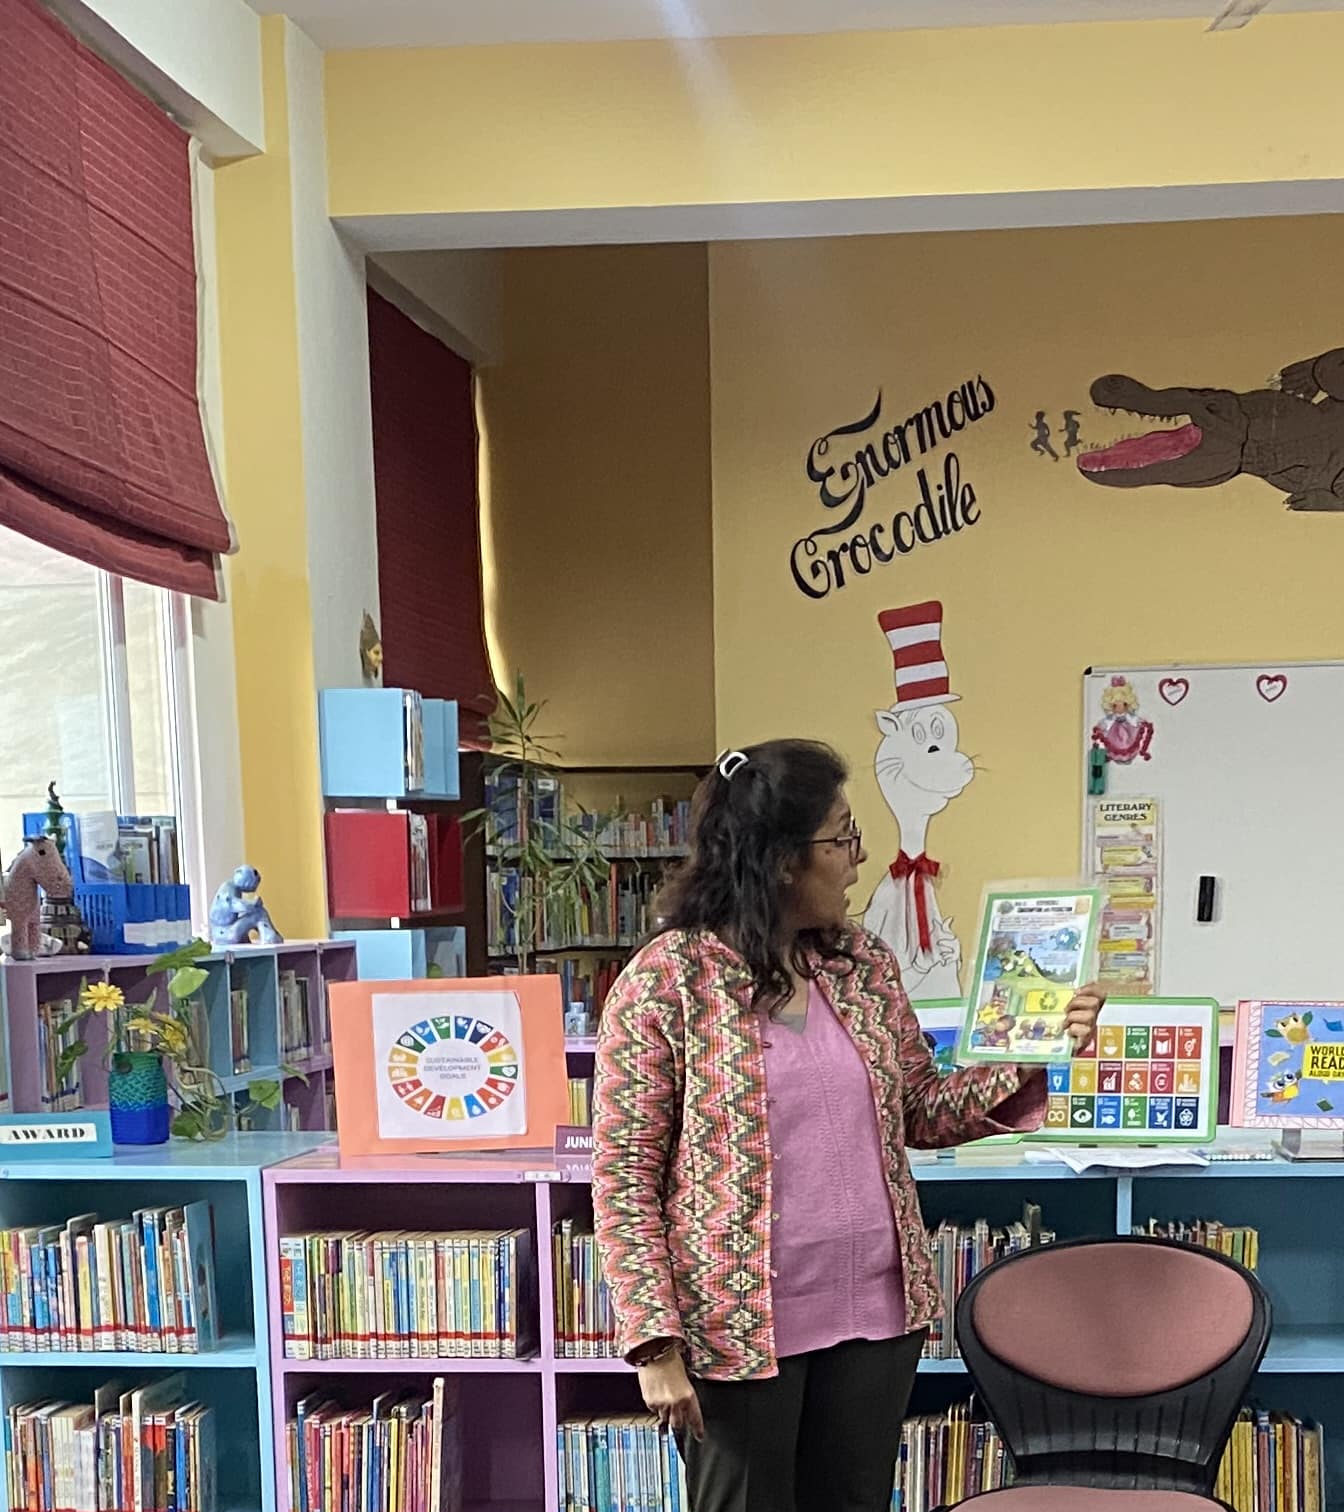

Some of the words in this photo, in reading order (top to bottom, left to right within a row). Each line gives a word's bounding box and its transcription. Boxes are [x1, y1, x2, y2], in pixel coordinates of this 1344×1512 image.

[806, 374, 996, 508] Enormous
[789, 452, 982, 599] Crocodile
[1099, 803, 1153, 812] LITERARY
[1104, 813, 1147, 822] GENRES
[8, 1127, 85, 1140] AWARD
[564, 1136, 592, 1149] JUNI
